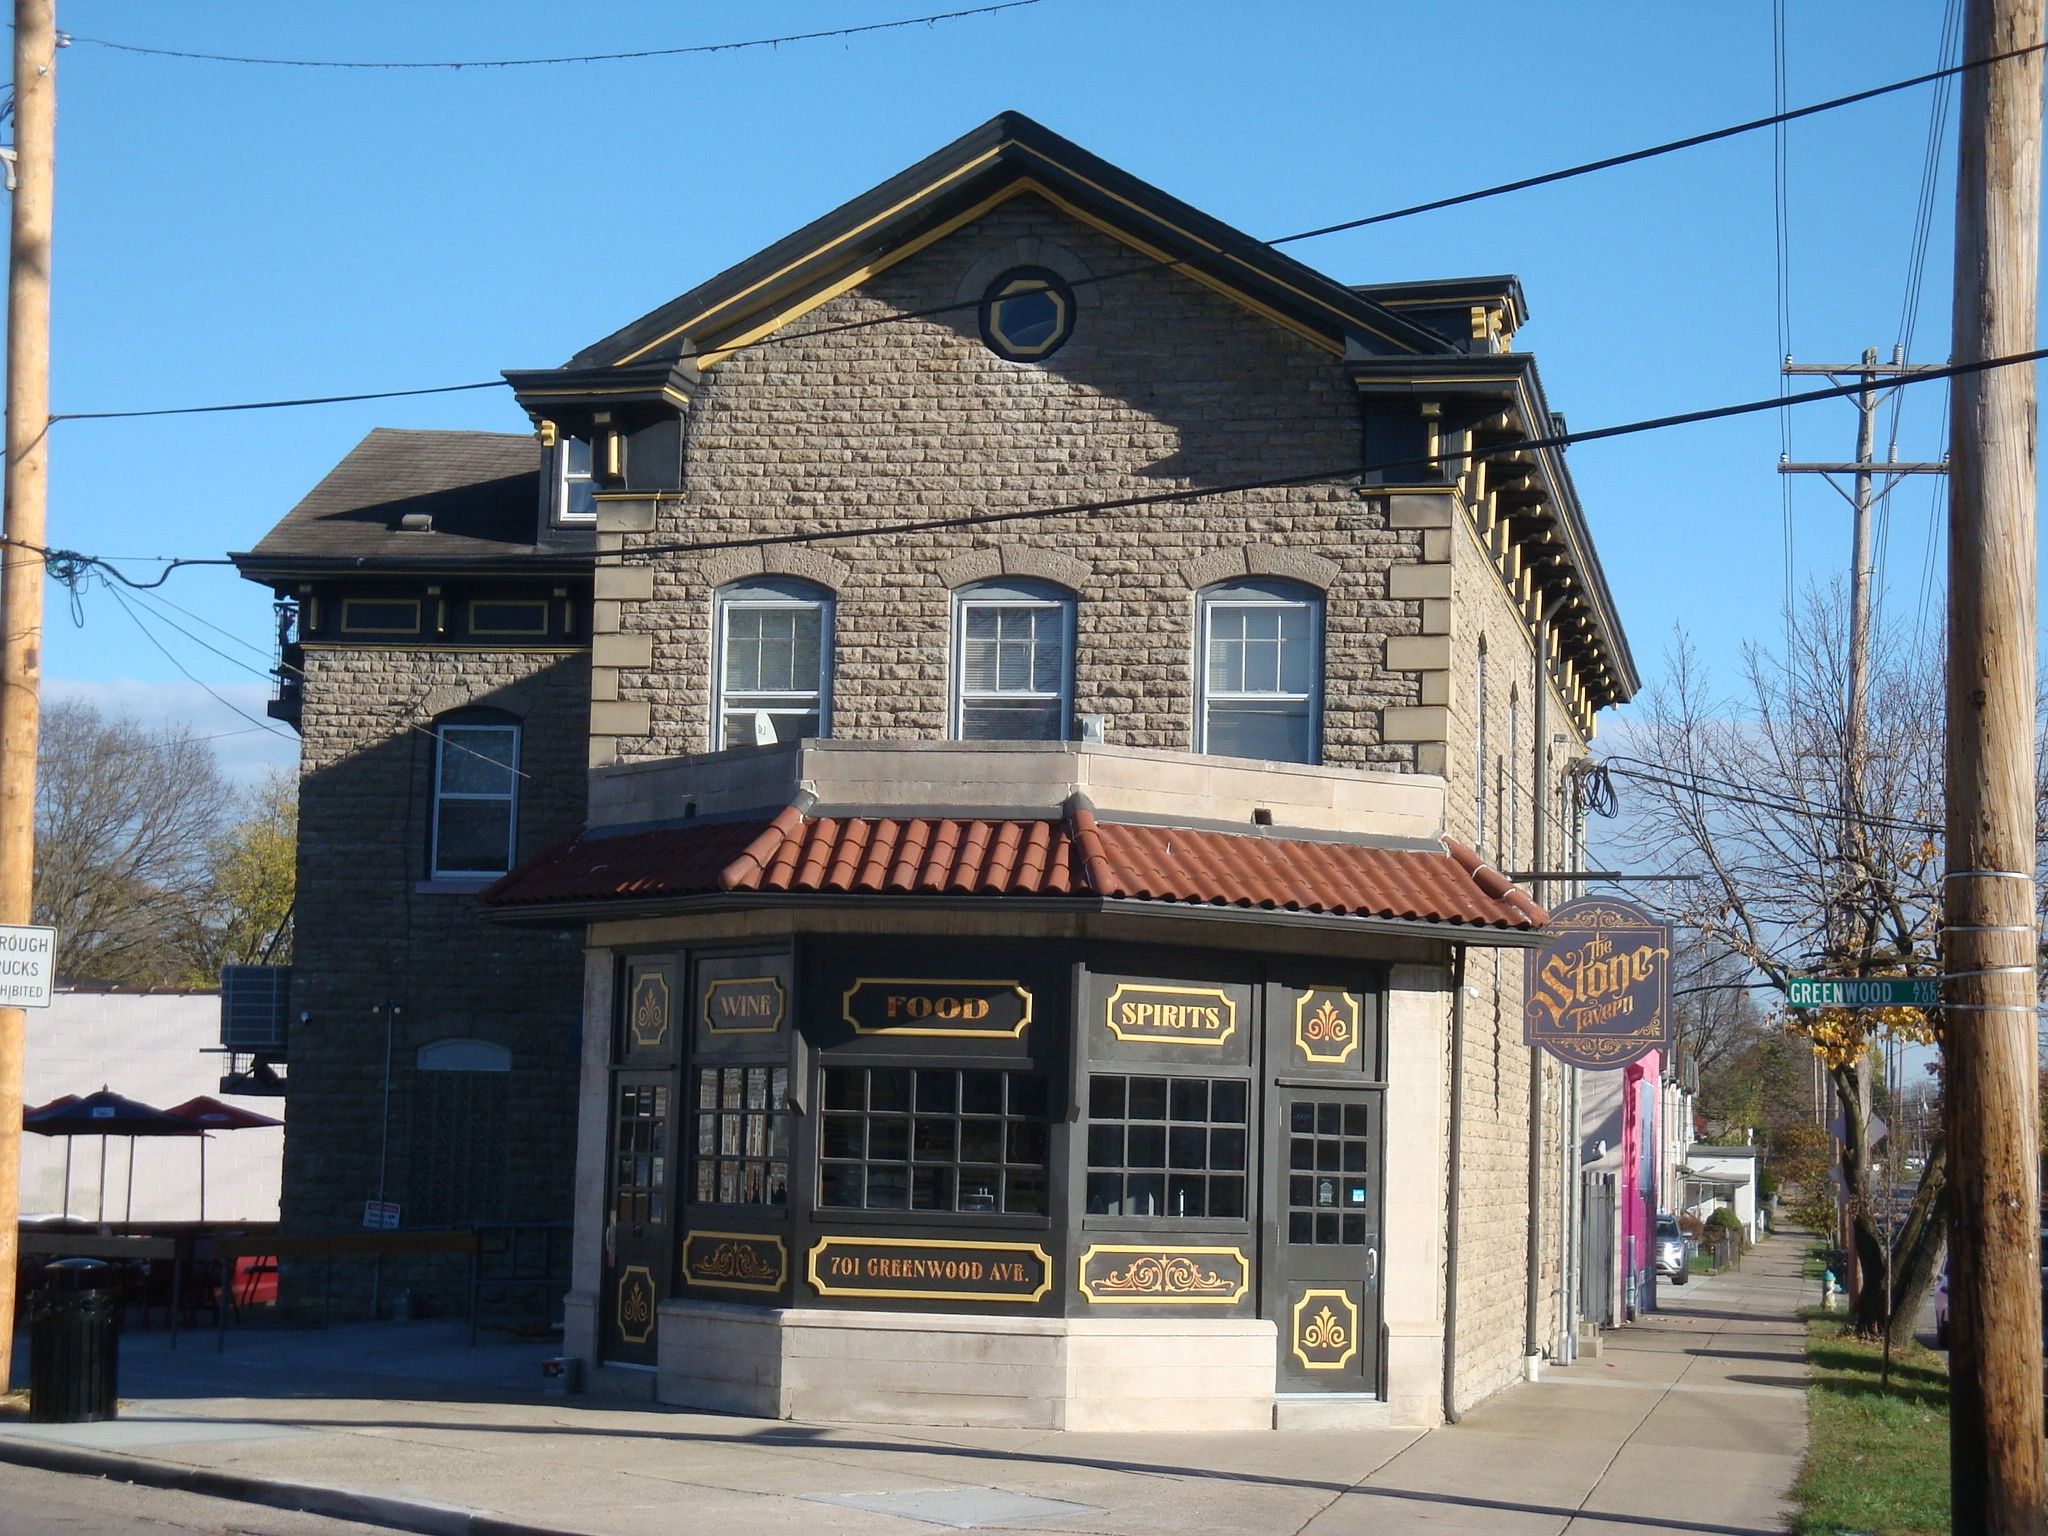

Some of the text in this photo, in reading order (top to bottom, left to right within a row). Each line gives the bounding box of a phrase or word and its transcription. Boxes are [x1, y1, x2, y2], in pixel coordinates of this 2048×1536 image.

[1584, 929, 1612, 960] The
[0, 960, 39, 977] UCKS
[1526, 944, 1670, 1029] Stone
[1790, 981, 1936, 1004] GREENWOOD AVE
[720, 995, 771, 1017] WINE
[887, 996, 989, 1019] FOOD
[1121, 1002, 1220, 1029] SPIRITS
[1566, 995, 1634, 1033] Tavern
[831, 1257, 1030, 1282] 701 GREENWOOD AVE.
